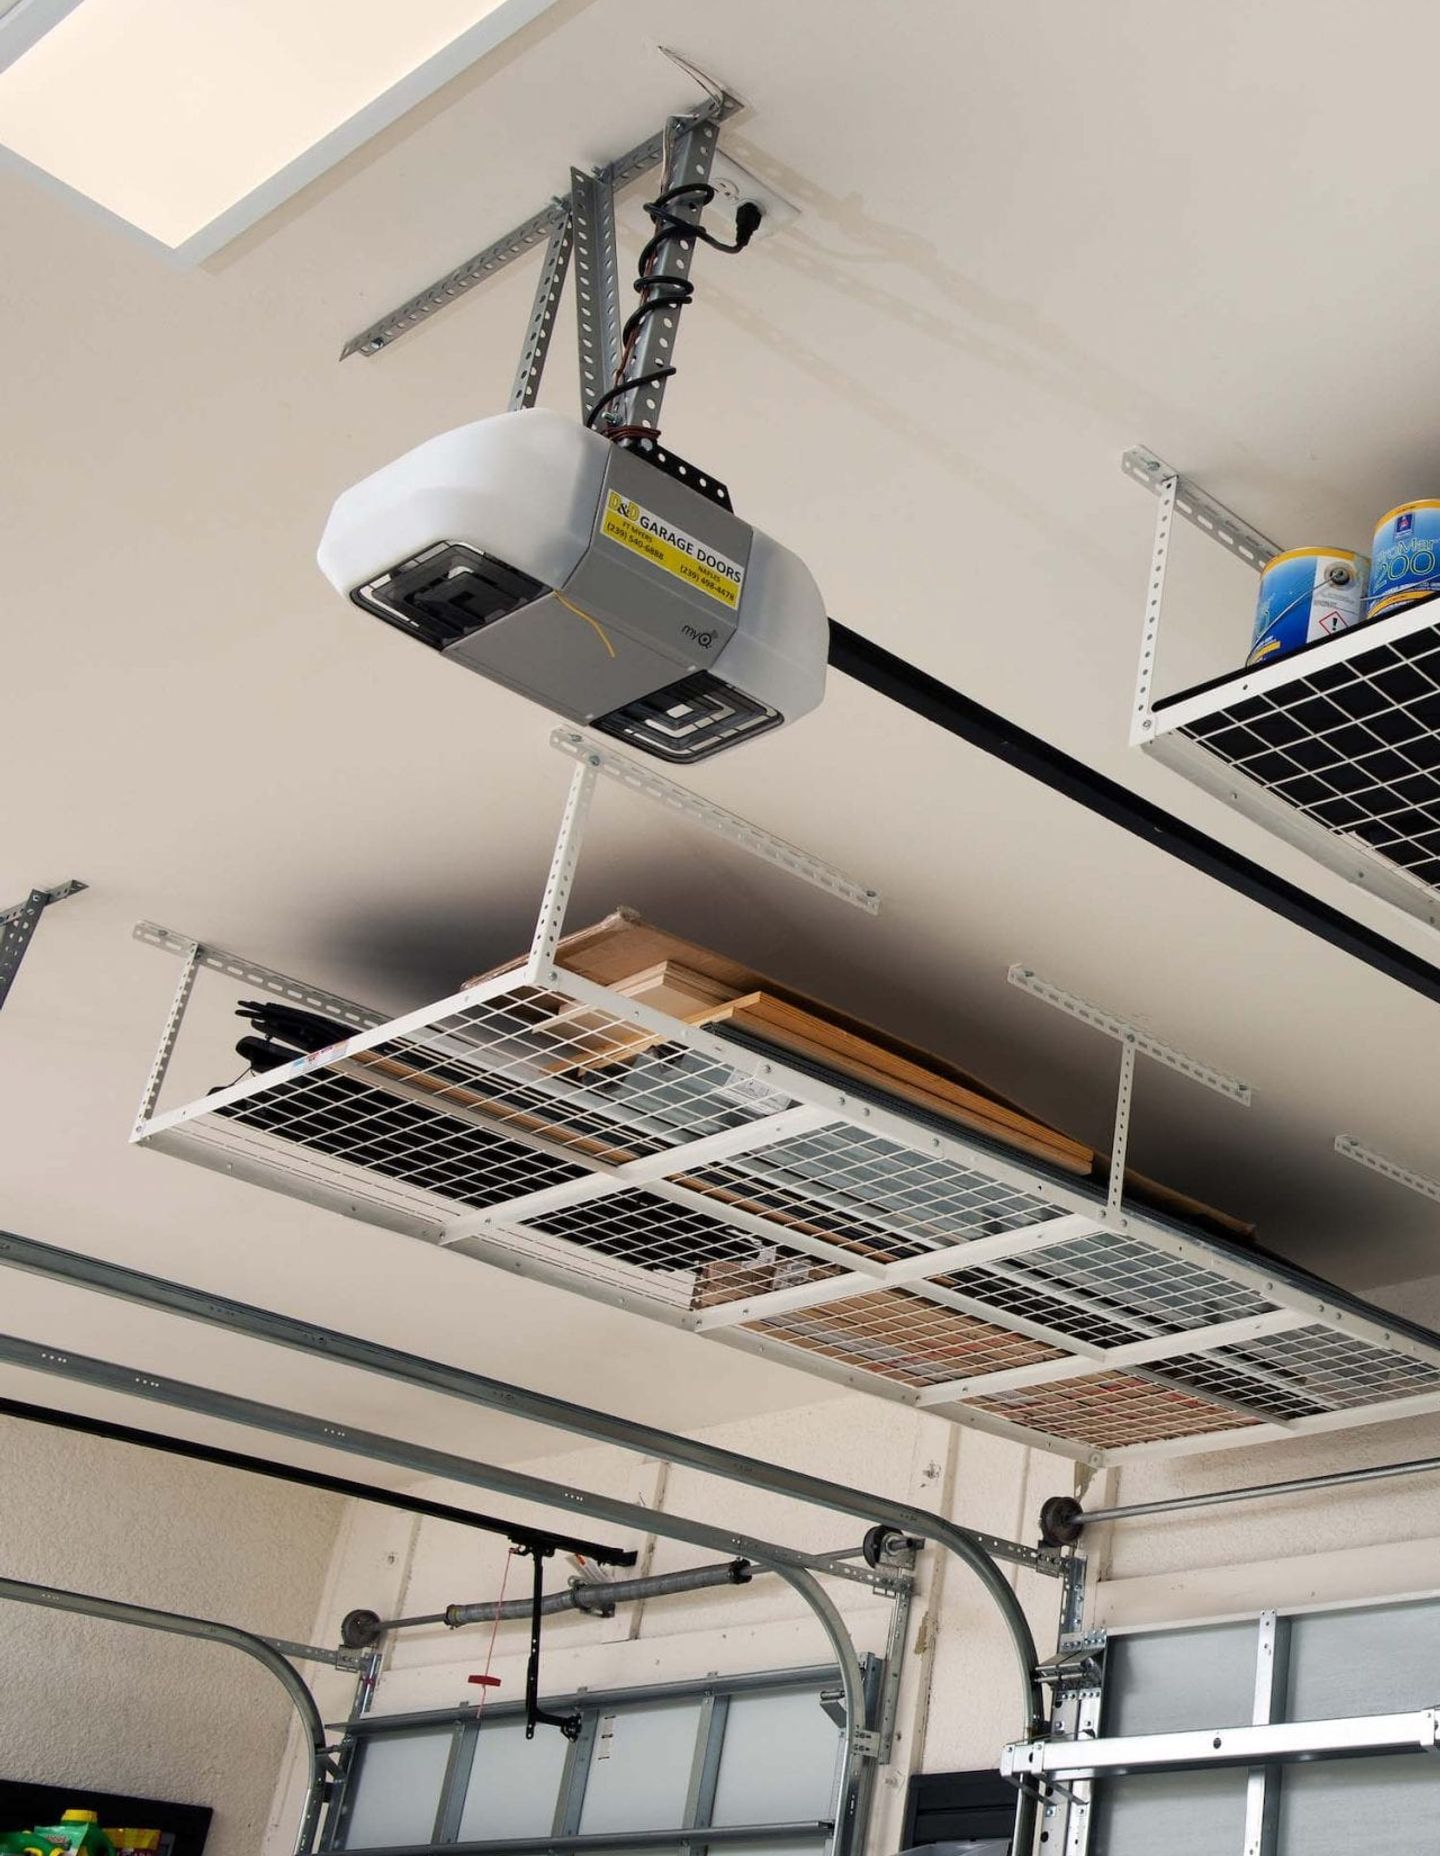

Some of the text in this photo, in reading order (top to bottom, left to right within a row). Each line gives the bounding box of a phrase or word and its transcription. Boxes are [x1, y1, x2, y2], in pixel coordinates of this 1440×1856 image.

[640, 516, 694, 555] GARAGE
[697, 549, 741, 583] DOORS
[1373, 551, 1435, 594] 200
